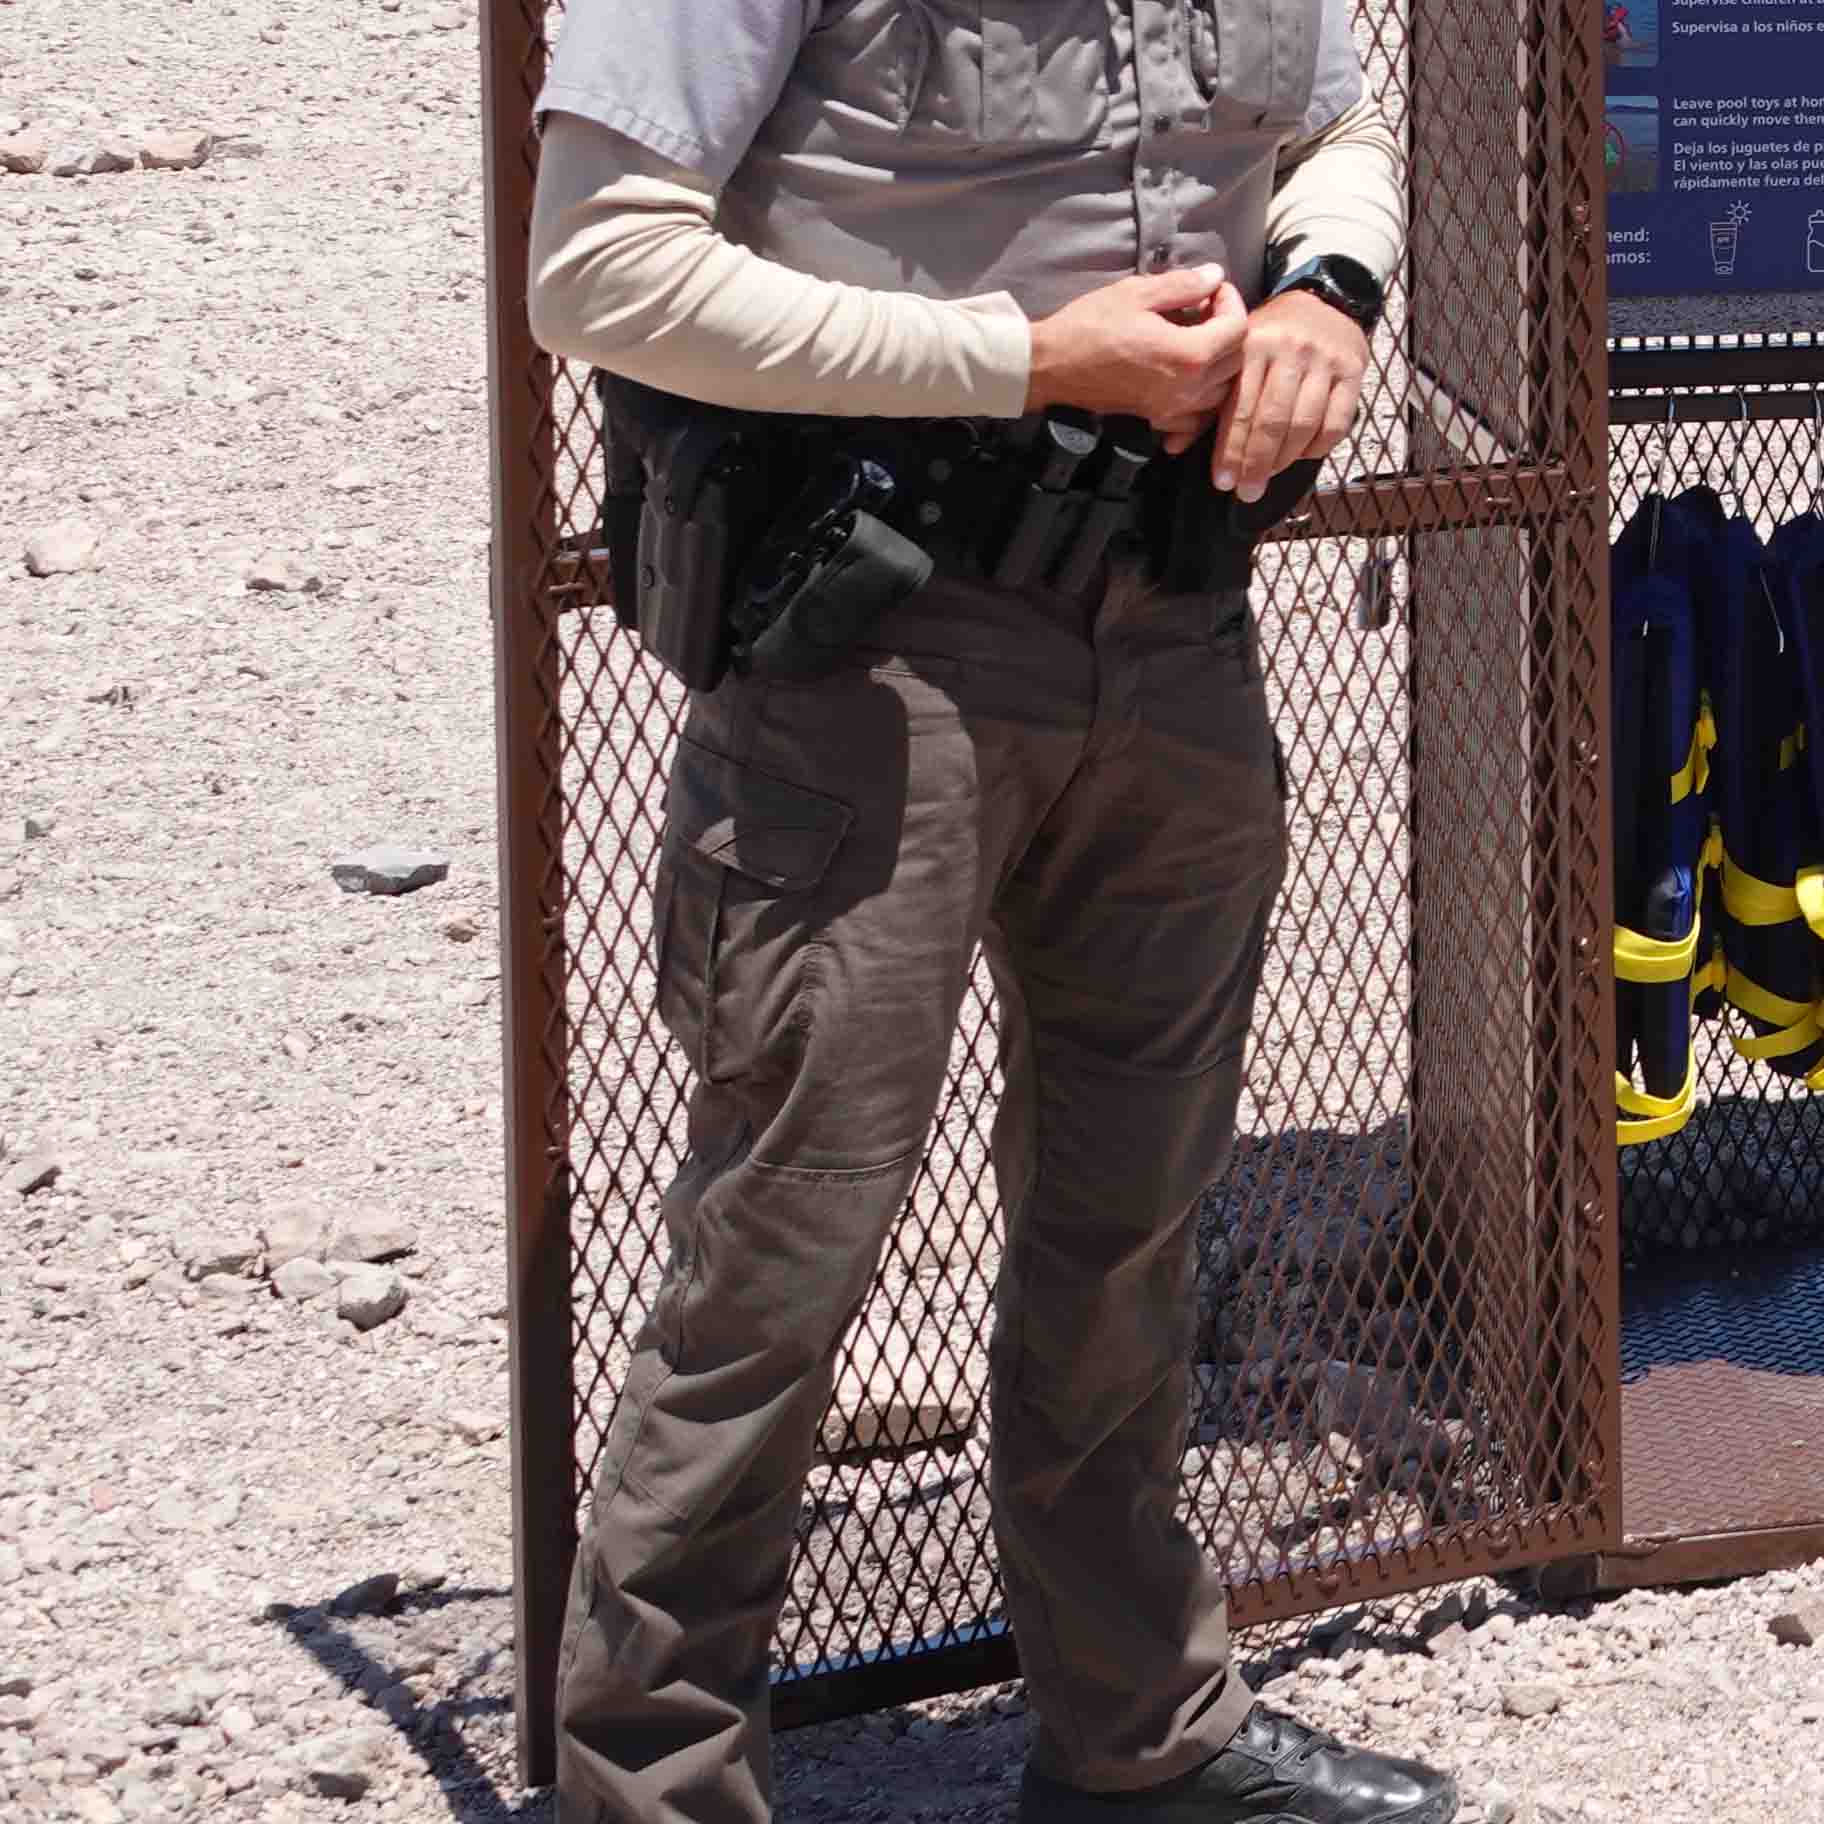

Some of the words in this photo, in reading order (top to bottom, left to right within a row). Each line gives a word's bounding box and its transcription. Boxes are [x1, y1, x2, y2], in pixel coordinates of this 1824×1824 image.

[1672, 21, 1738, 35] Supervisa
[1742, 24, 1749, 32] a
[1754, 21, 1773, 32] los
[1777, 20, 1813, 32] niños
[1674, 98, 1713, 109] Leave
[1717, 96, 1747, 112] pool
[1751, 98, 1780, 111] toys
[1784, 97, 1797, 108] at
[1673, 118, 1696, 127] can
[1701, 113, 1748, 128] quickly
[1753, 116, 1790, 125] move
[1674, 142, 1704, 157] Deja
[1709, 142, 1727, 153] los
[1731, 142, 1789, 156] juguetes
[1793, 140, 1809, 152] de
[1674, 160, 1685, 171] El
[1690, 160, 1733, 171] viento
[1737, 160, 1745, 173] y
[1749, 158, 1767, 169] las
[1771, 158, 1798, 170] olas
[1764, 174, 1800, 186] fuera
[1804, 173, 1824, 185] del
[1606, 227, 1650, 244] end:
